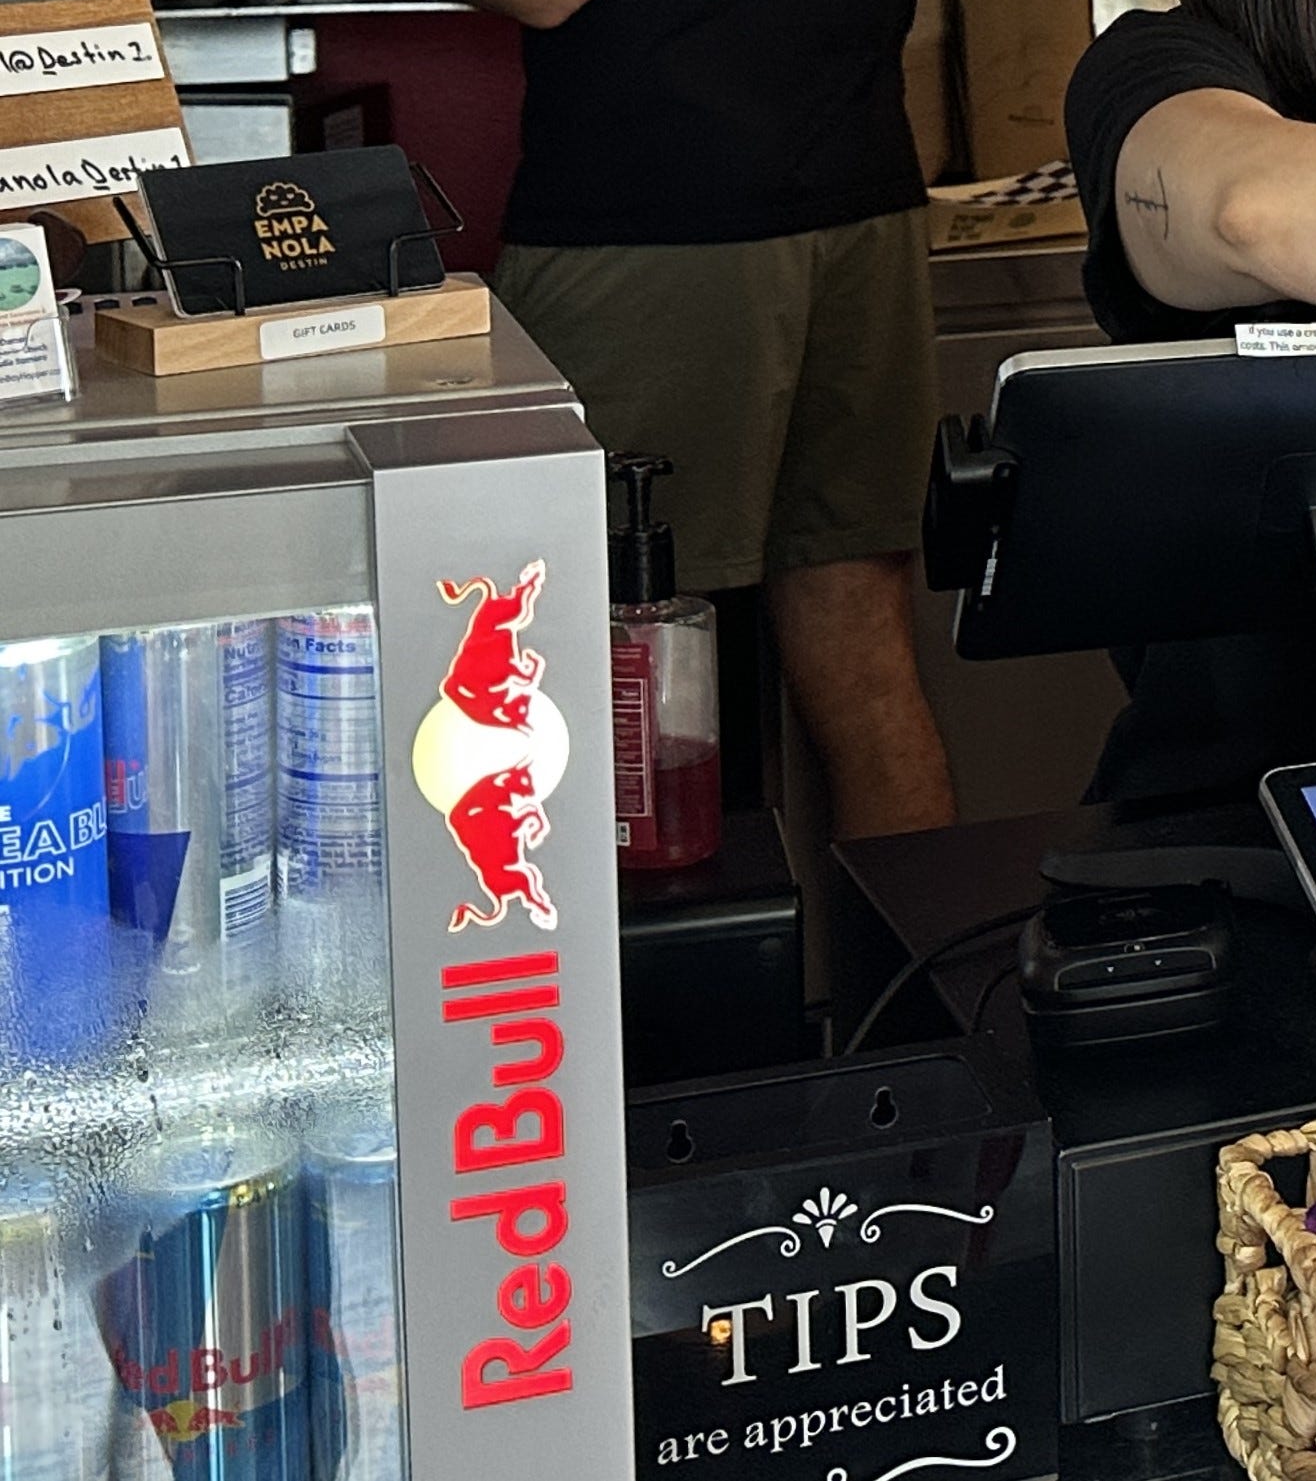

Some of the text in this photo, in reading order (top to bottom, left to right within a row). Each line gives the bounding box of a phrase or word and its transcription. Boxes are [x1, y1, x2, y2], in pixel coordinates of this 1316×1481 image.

[254, 214, 329, 240] EMPA
[261, 235, 335, 261] NOLA
[280, 257, 328, 272] DESTIN
[293, 319, 357, 340] GIFT CARDS
[306, 638, 356, 653] Facts
[0, 820, 66, 864] EA
[440, 950, 574, 1412] Red Bull
[702, 1266, 962, 1387] TIPS
[657, 1364, 1007, 1466] are appreciated
